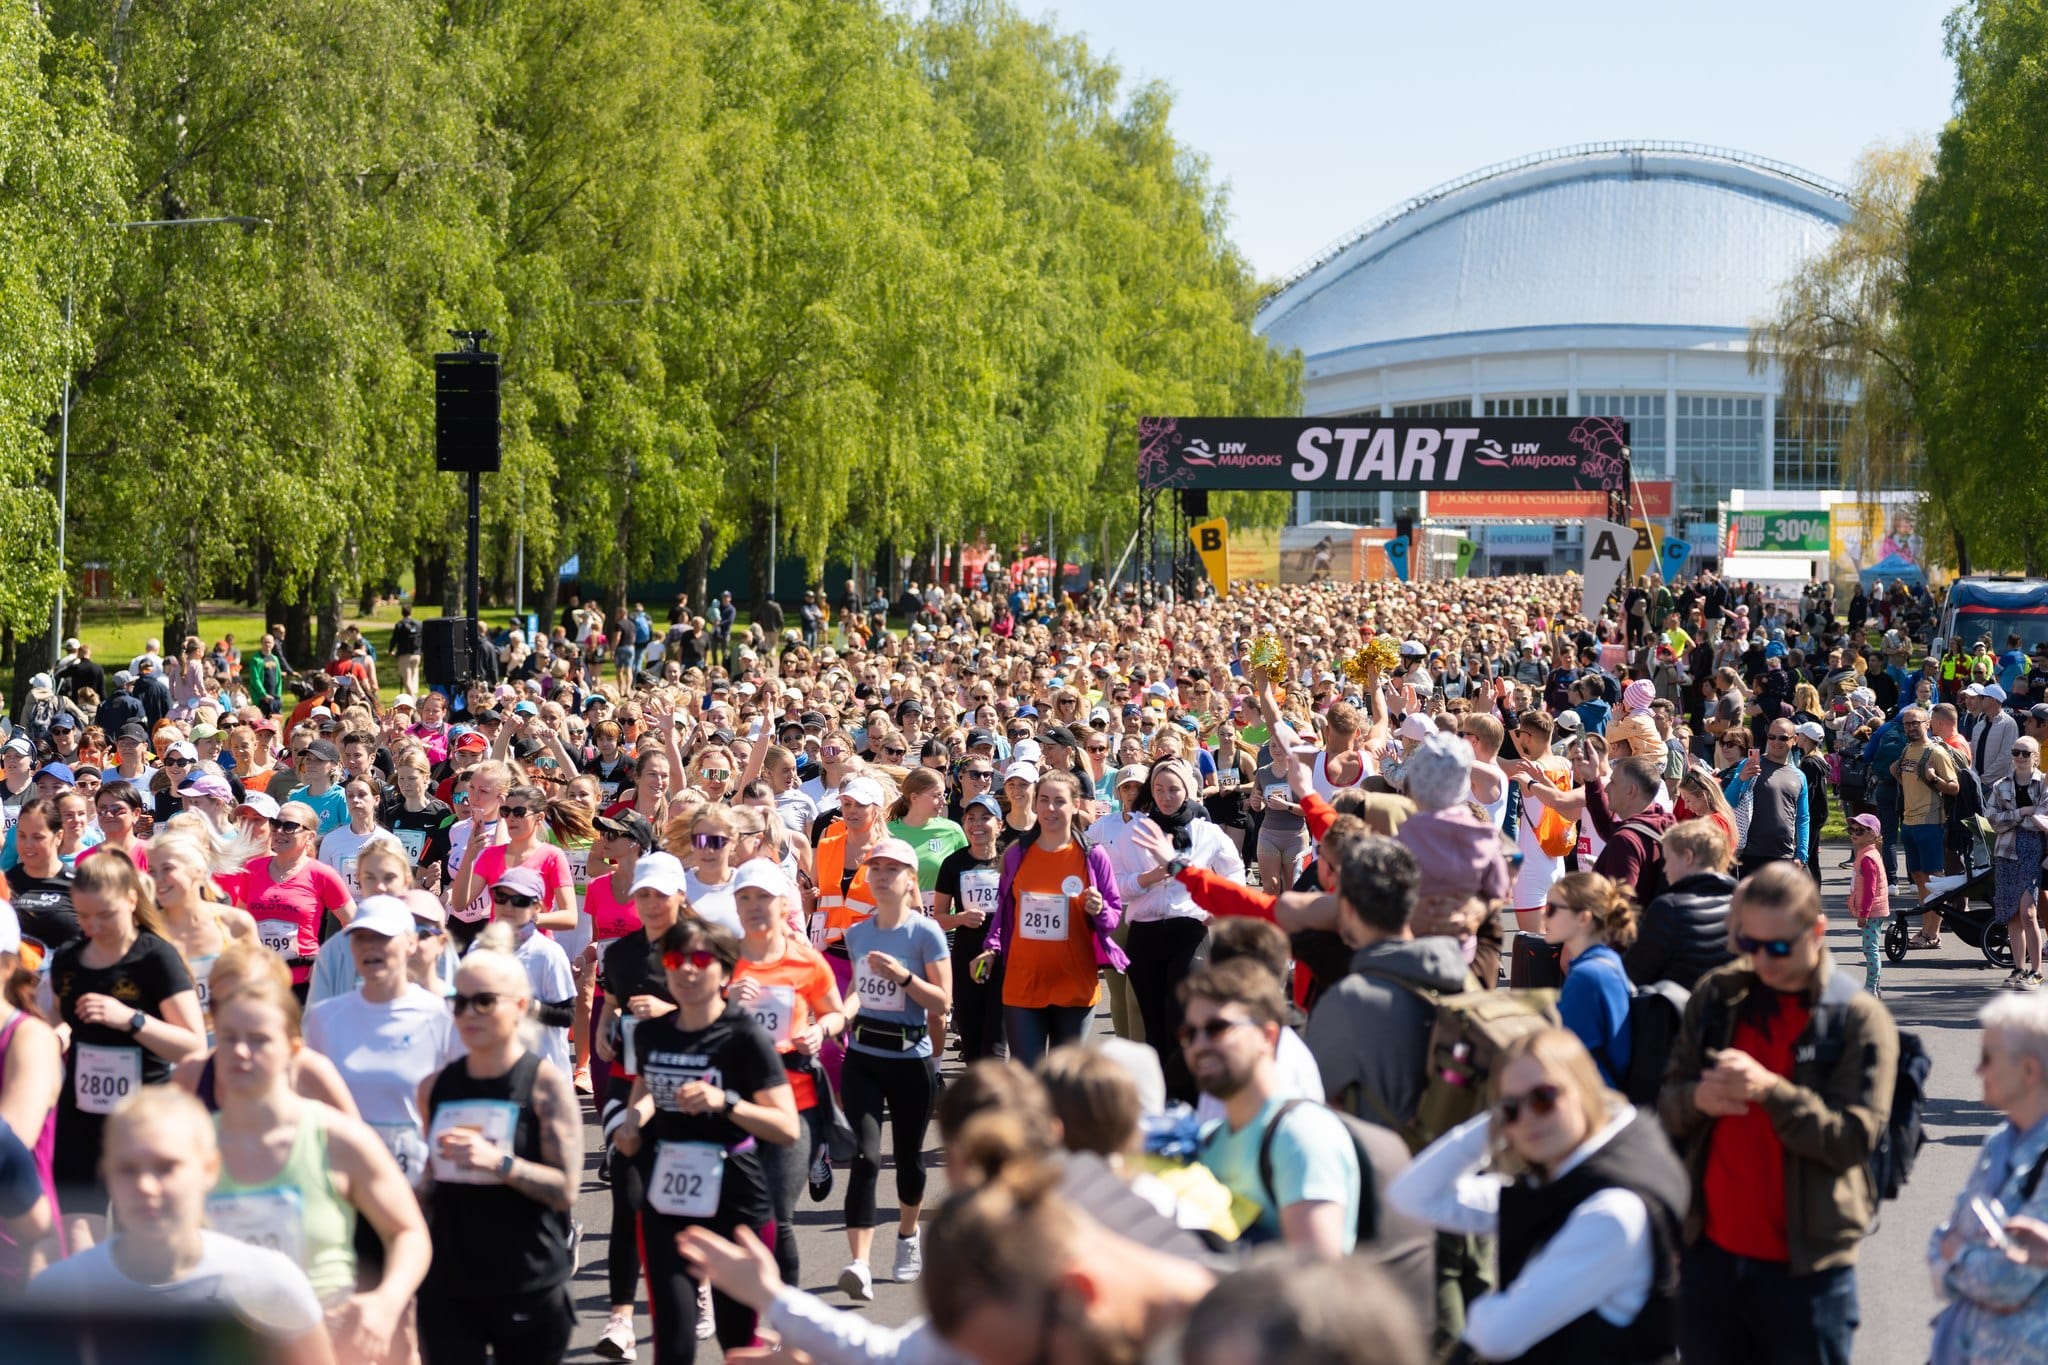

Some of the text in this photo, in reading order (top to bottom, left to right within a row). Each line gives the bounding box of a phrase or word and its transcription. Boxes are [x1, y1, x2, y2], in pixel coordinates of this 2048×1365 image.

[1218, 443, 1247, 454] LHV
[1291, 427, 1480, 481] START
[1511, 443, 1541, 454] LHV
[1218, 454, 1282, 468] MAIJOOKS
[1511, 454, 1577, 468] MAIJOOKS
[1487, 493, 1520, 505] oma
[1633, 527, 1653, 550] B
[1768, 518, 1826, 542] -30%
[1201, 528, 1222, 551] B
[1590, 531, 1621, 561] A
[1733, 531, 1765, 548] AUP
[1391, 543, 1404, 557] C
[1459, 543, 1471, 556] D
[1668, 543, 1683, 559] C
[1025, 912, 1060, 929] 2816
[260, 937, 290, 951] 599
[860, 977, 896, 996] 2669
[80, 1073, 129, 1097] 2800
[663, 1172, 703, 1197] 202
